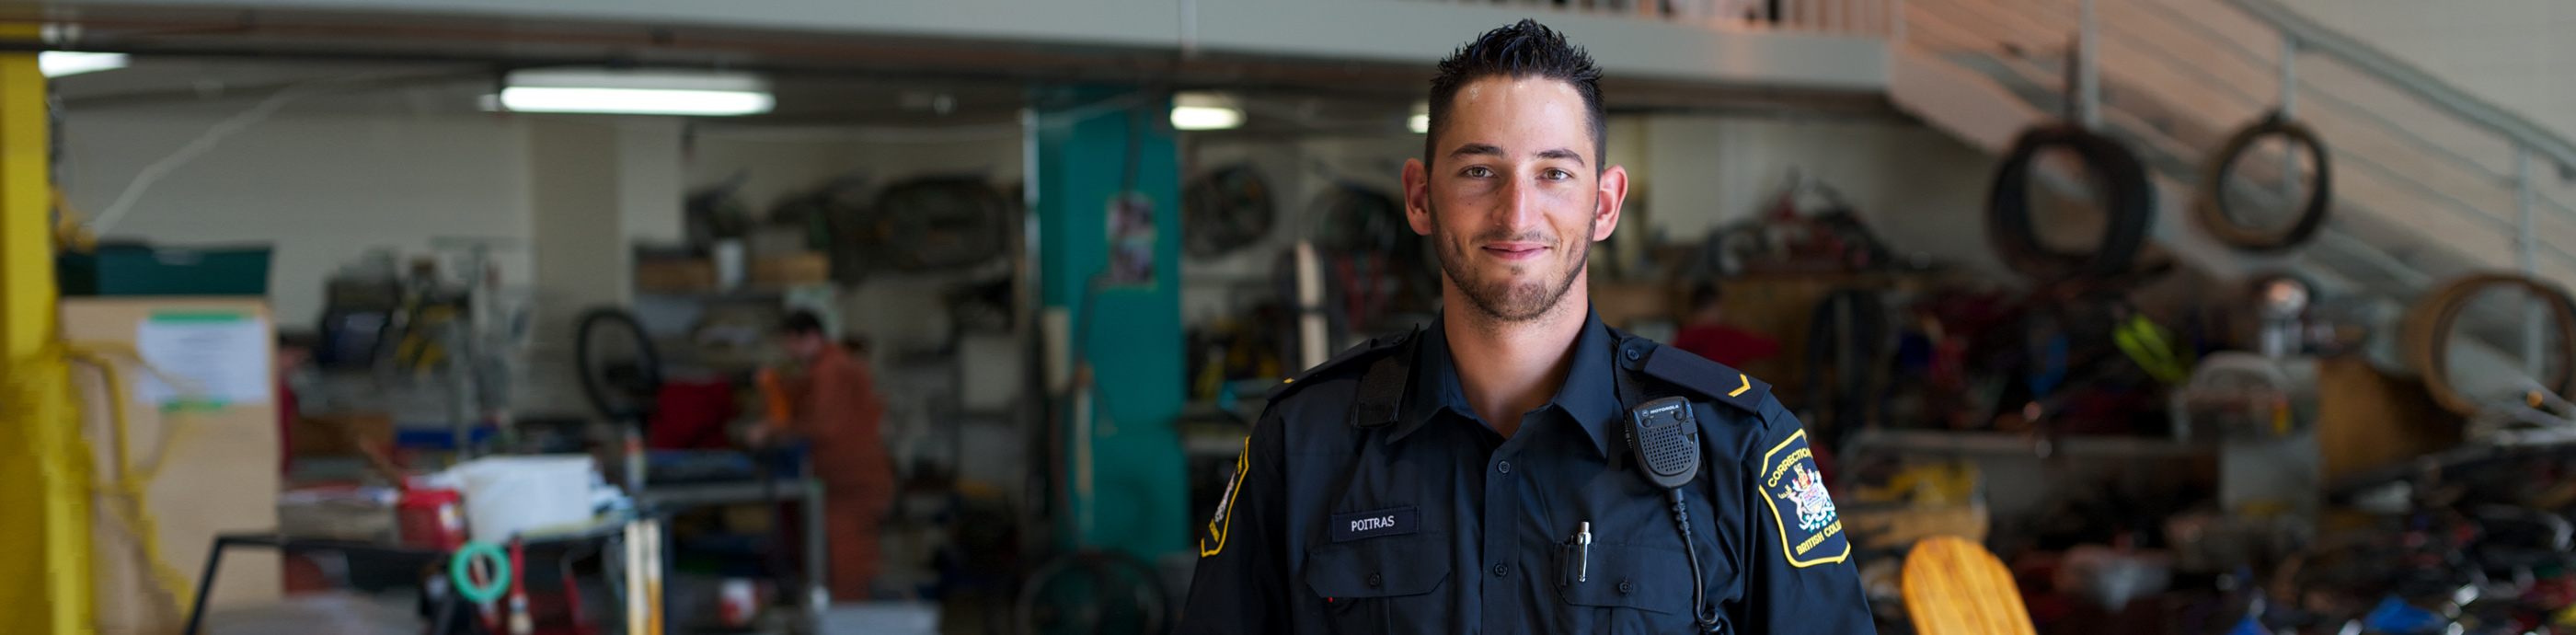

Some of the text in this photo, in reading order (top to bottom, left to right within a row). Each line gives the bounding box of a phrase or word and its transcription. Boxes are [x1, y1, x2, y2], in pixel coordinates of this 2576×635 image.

[1650, 404, 1680, 414] MOTOROLA
[1351, 515, 1395, 532] POITRAS
[1796, 531, 1825, 556] BRITISH
